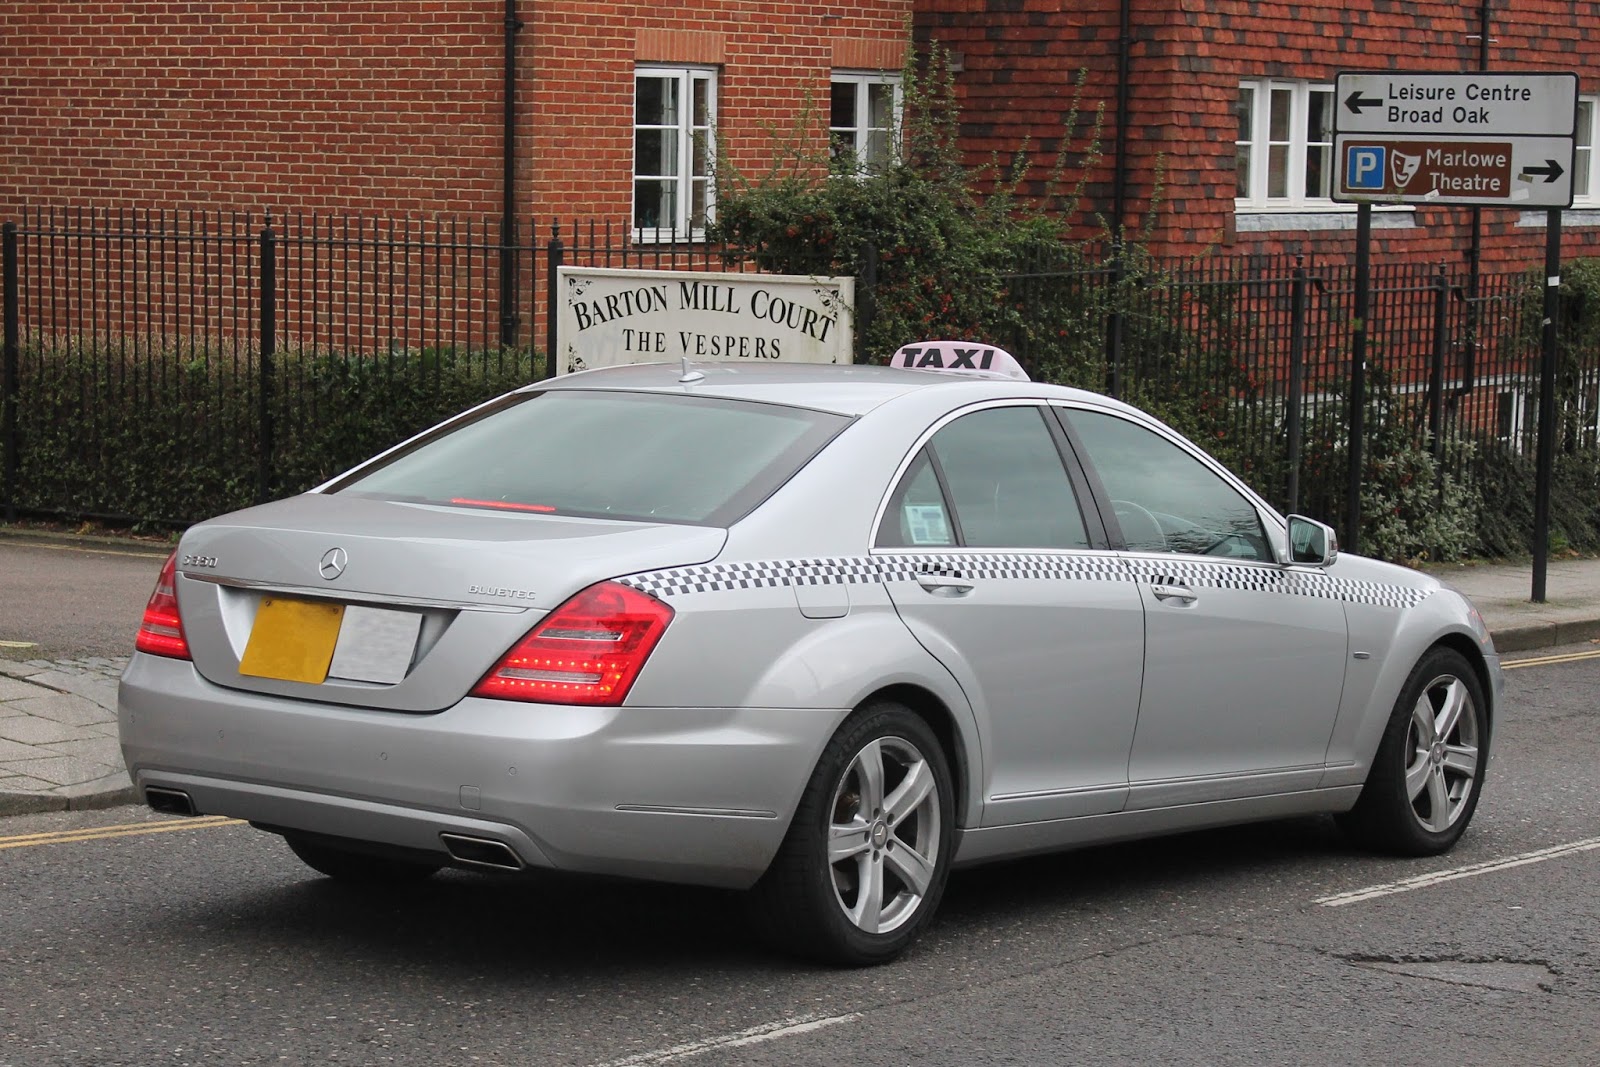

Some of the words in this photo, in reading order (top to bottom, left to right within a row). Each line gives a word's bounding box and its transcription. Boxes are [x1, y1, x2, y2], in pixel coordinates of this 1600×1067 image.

[1388, 83, 1456, 101] Leisure
[1465, 83, 1532, 101] Centre
[1388, 106, 1443, 123] Broad
[1453, 106, 1490, 124] Oak
[1425, 148, 1507, 167] Marlowe
[1356, 152, 1377, 183] P
[1429, 172, 1501, 191] Theatre
[573, 285, 668, 331] BARTON
[679, 281, 741, 314] MILL
[751, 289, 836, 343] COURT
[622, 328, 667, 352] THE
[679, 331, 781, 359] VESPERS
[901, 348, 995, 370] TAXI
[468, 584, 536, 600] BLUETEC
